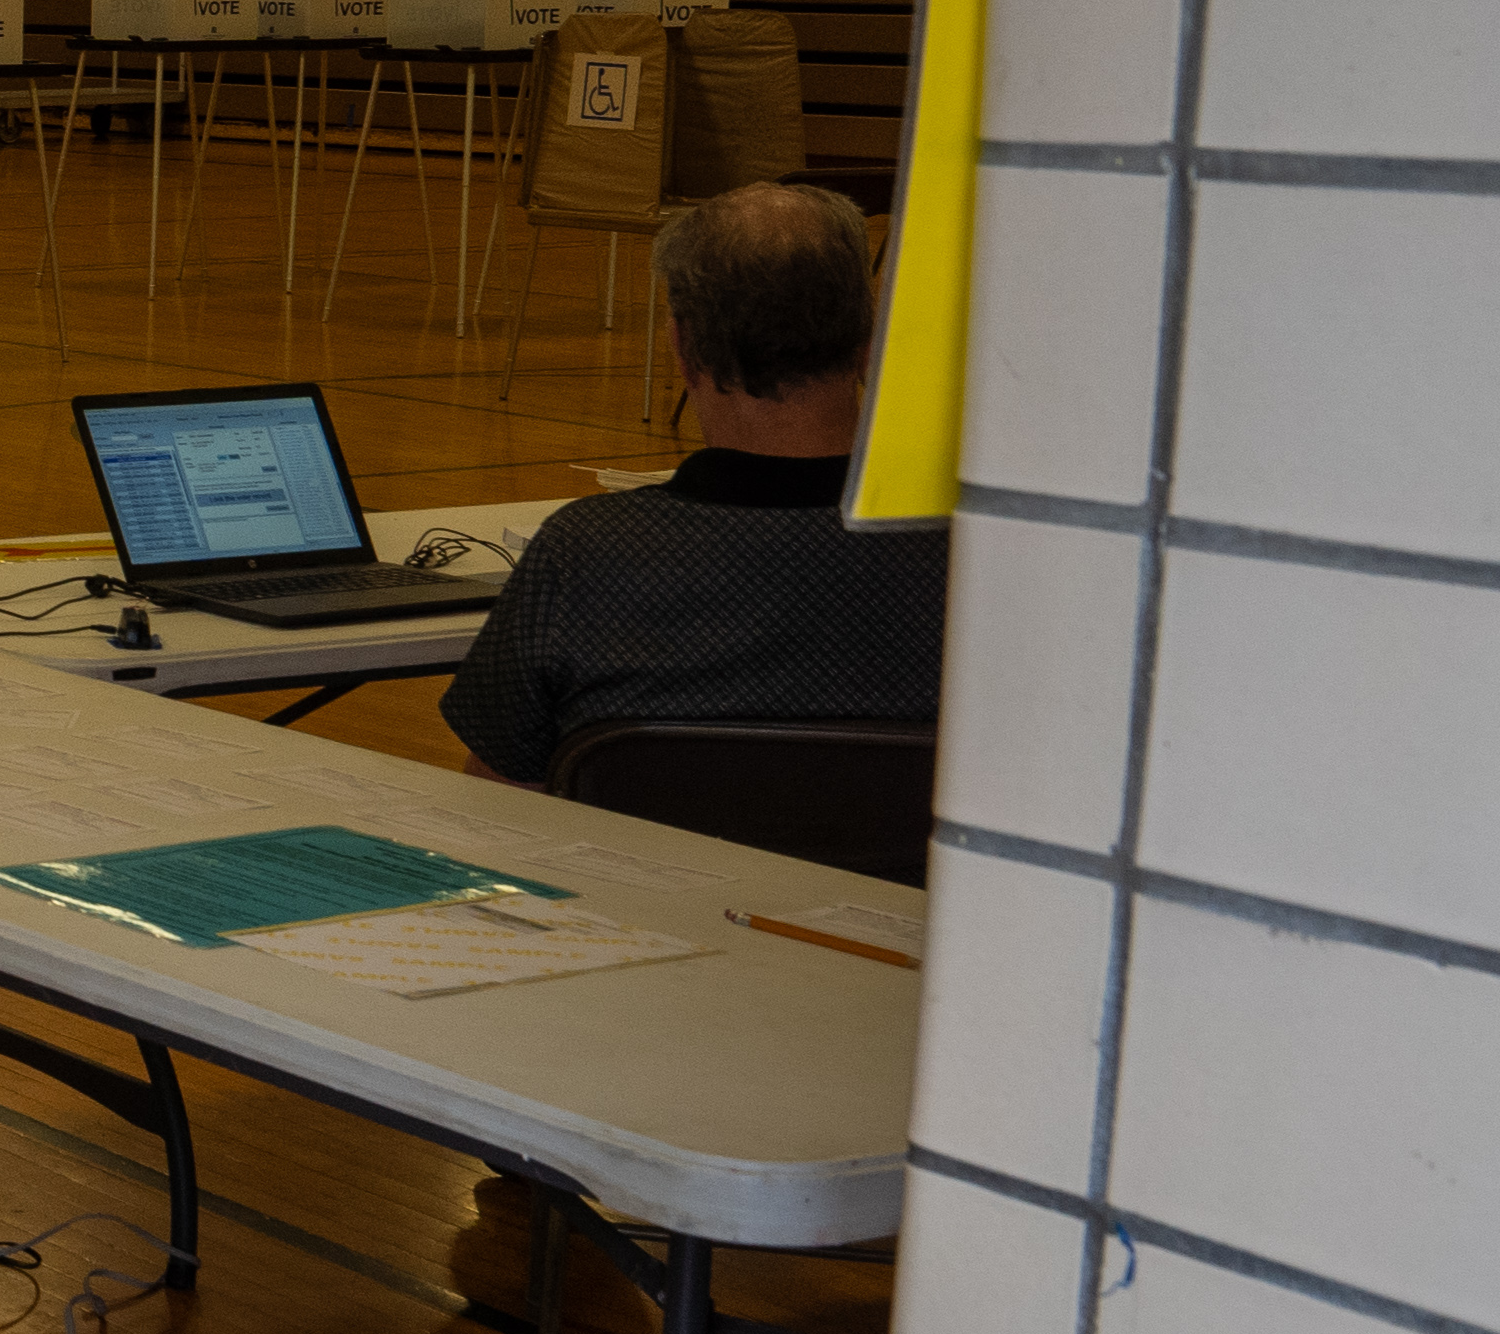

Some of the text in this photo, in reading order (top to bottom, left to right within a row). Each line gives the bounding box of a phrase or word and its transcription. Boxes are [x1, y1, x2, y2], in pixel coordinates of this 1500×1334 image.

[198, 1, 240, 15] VOTE
[257, 1, 295, 15] VOTE
[340, 2, 383, 15] VOTE
[515, 8, 560, 24] VOTE
